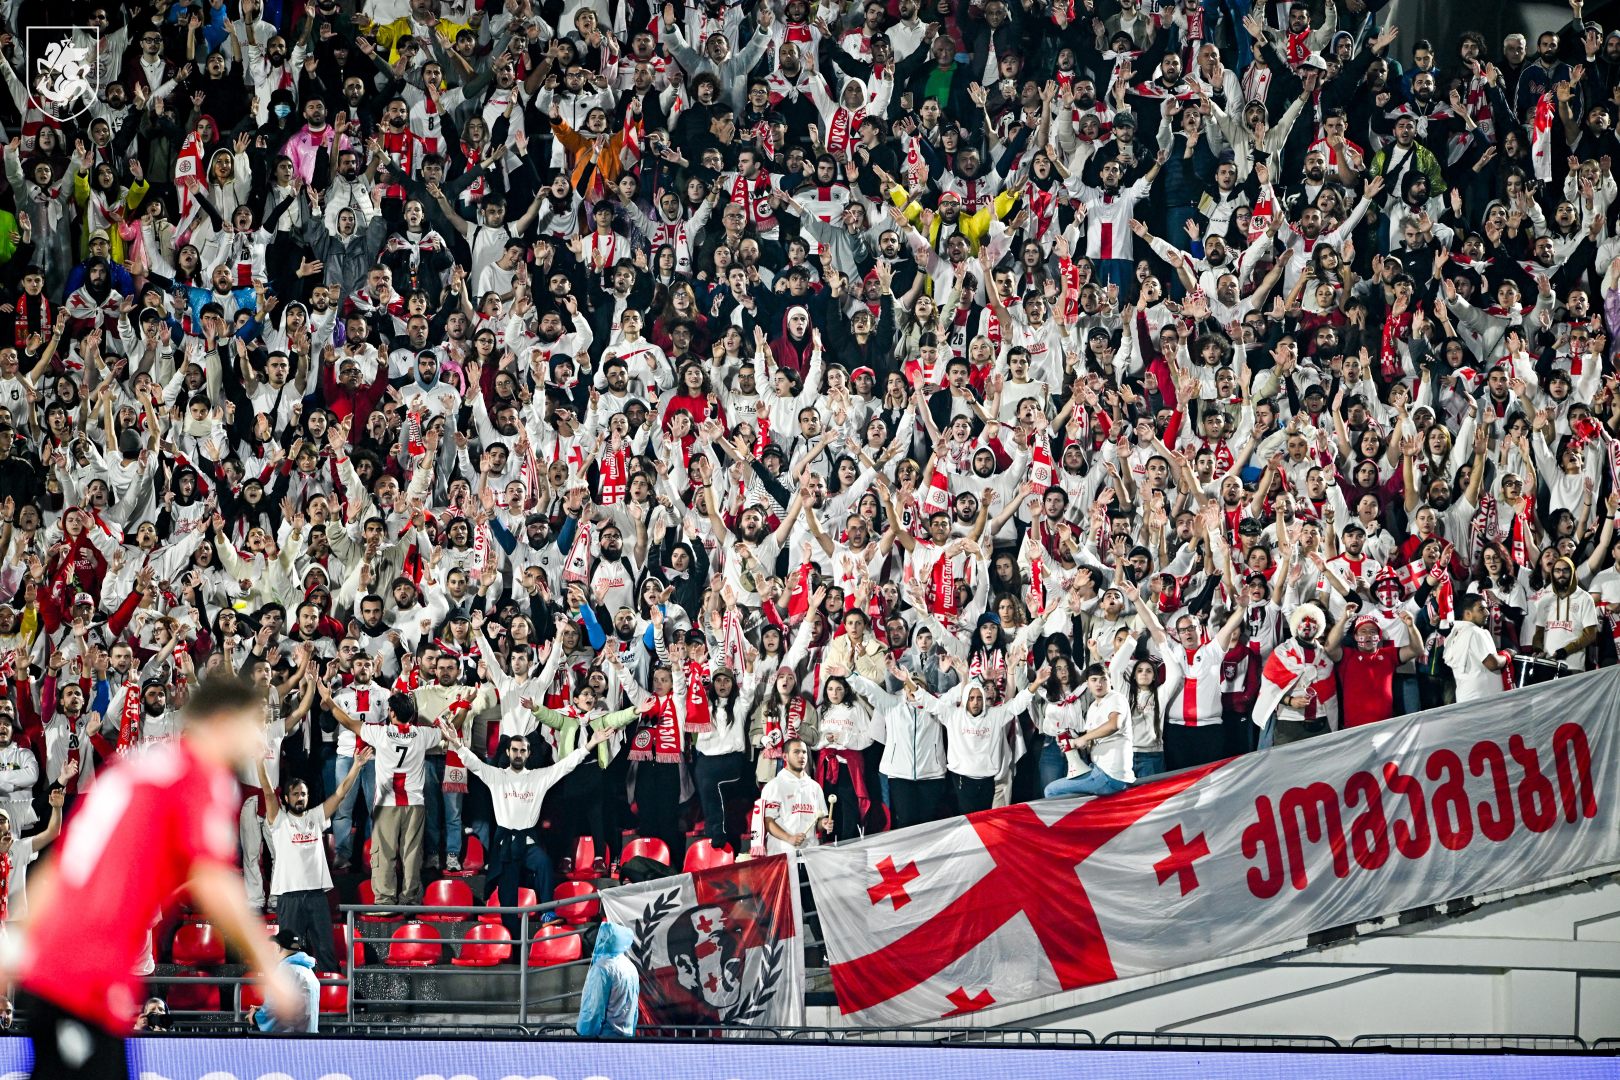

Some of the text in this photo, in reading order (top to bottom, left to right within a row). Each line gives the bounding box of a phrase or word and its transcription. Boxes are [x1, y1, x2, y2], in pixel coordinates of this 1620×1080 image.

[428, 119, 435, 131] 8
[953, 332, 964, 346] 26
[903, 511, 911, 527] 9
[68, 735, 79, 749] 20
[396, 745, 409, 768] 7
[1242, 723, 1597, 898] ქომაგები
